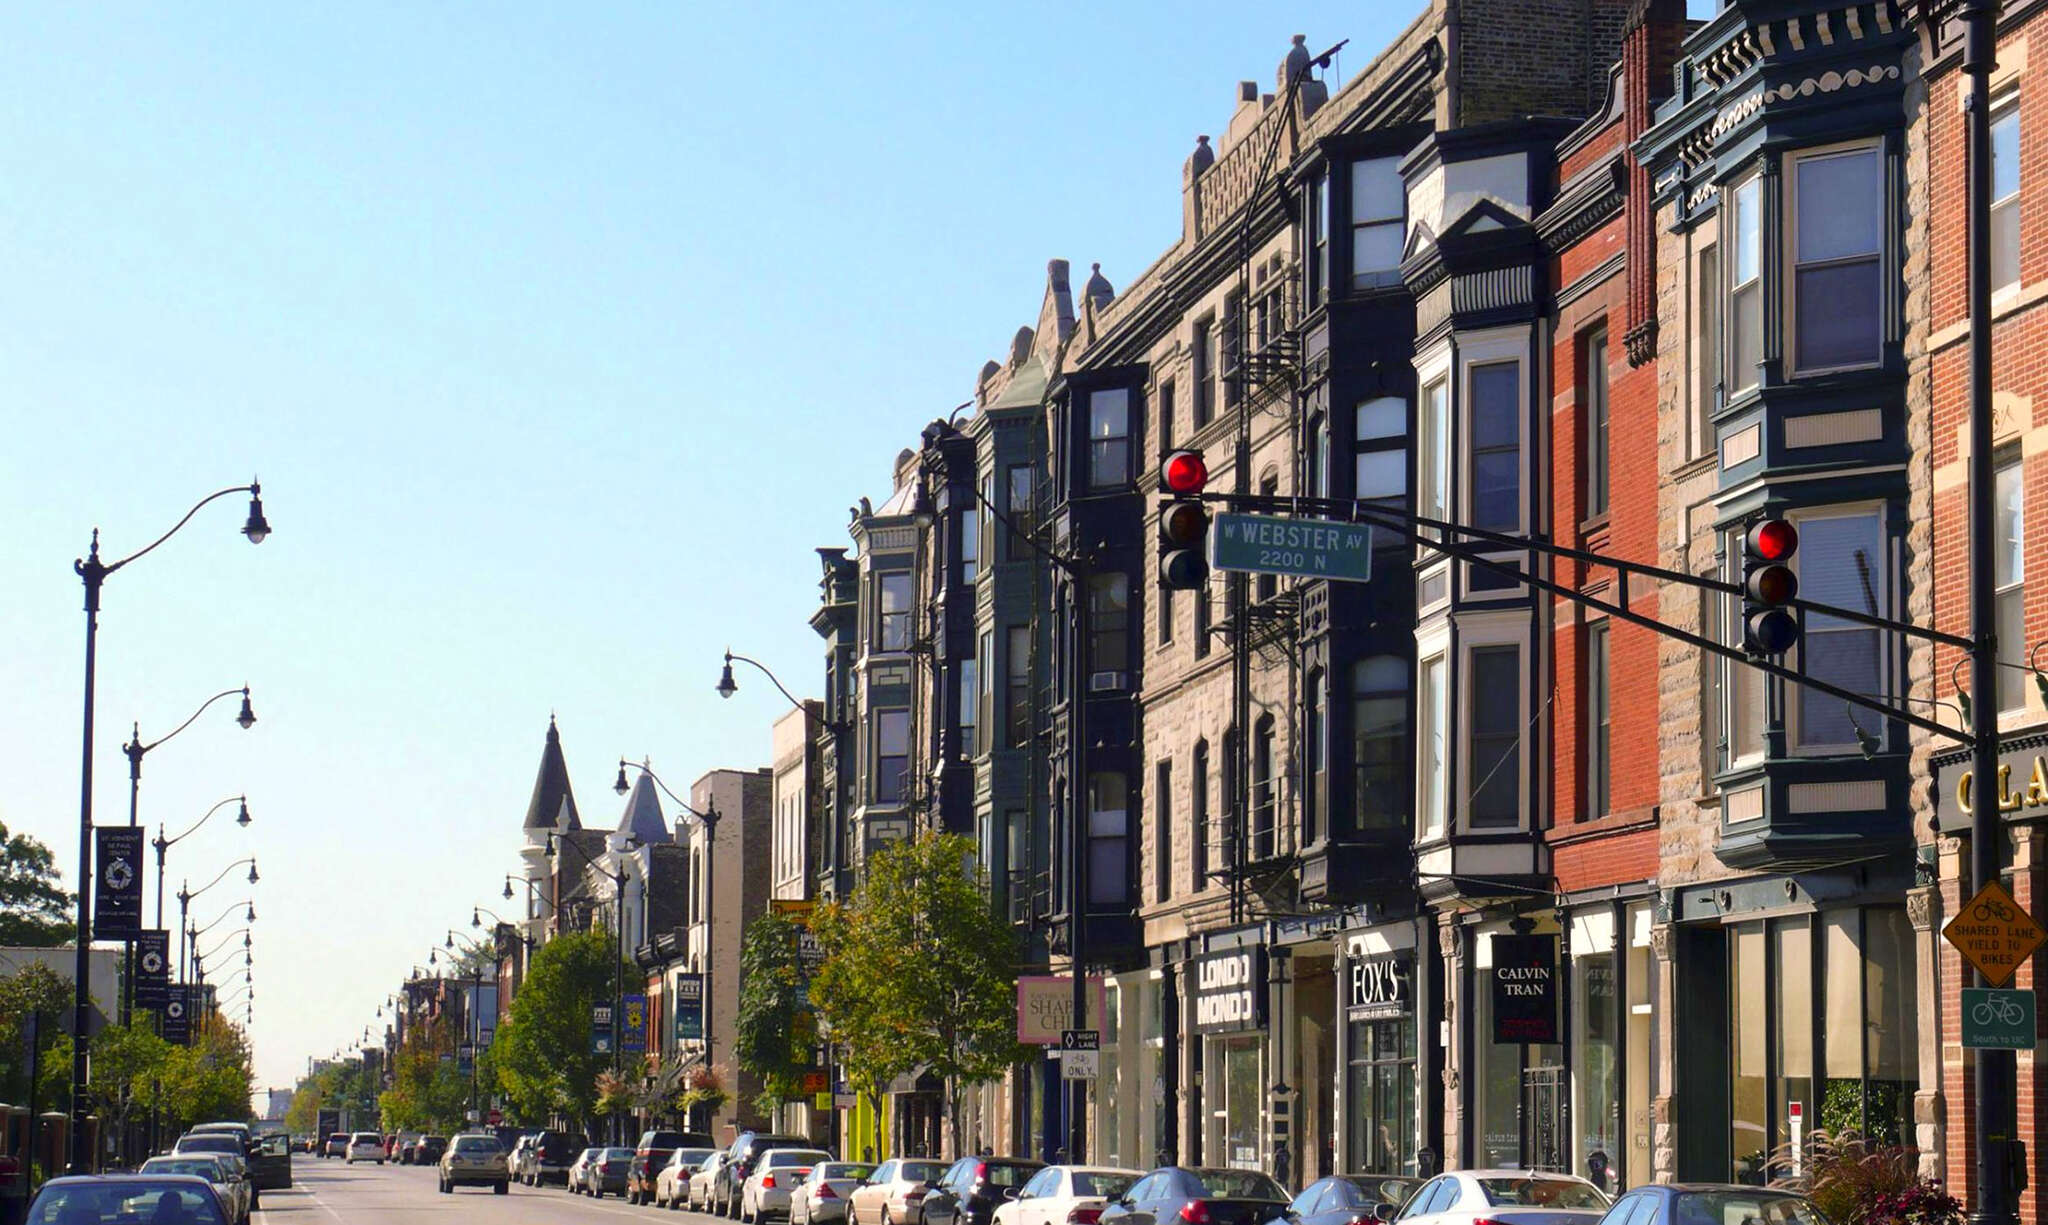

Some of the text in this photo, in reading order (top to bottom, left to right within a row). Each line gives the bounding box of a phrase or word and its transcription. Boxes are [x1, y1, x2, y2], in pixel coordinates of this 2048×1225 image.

[1224, 522, 1363, 550] W WEBSTER AV
[1259, 551, 1327, 570] 2200 N
[1954, 925, 2036, 939] SHARED LANE
[1967, 940, 2020, 950] YIELD TO
[1981, 953, 2013, 965] BIKES
[1498, 967, 1550, 980] CALVIN
[1353, 960, 1398, 1005] FOX'S
[1504, 984, 1544, 996] TRAN
[1077, 1032, 1097, 1040] RIGHT
[1972, 1034, 1998, 1043] South
[1999, 1035, 2009, 1043] to
[1078, 1041, 1097, 1049] LANE
[1068, 1066, 1093, 1076] ONLY
